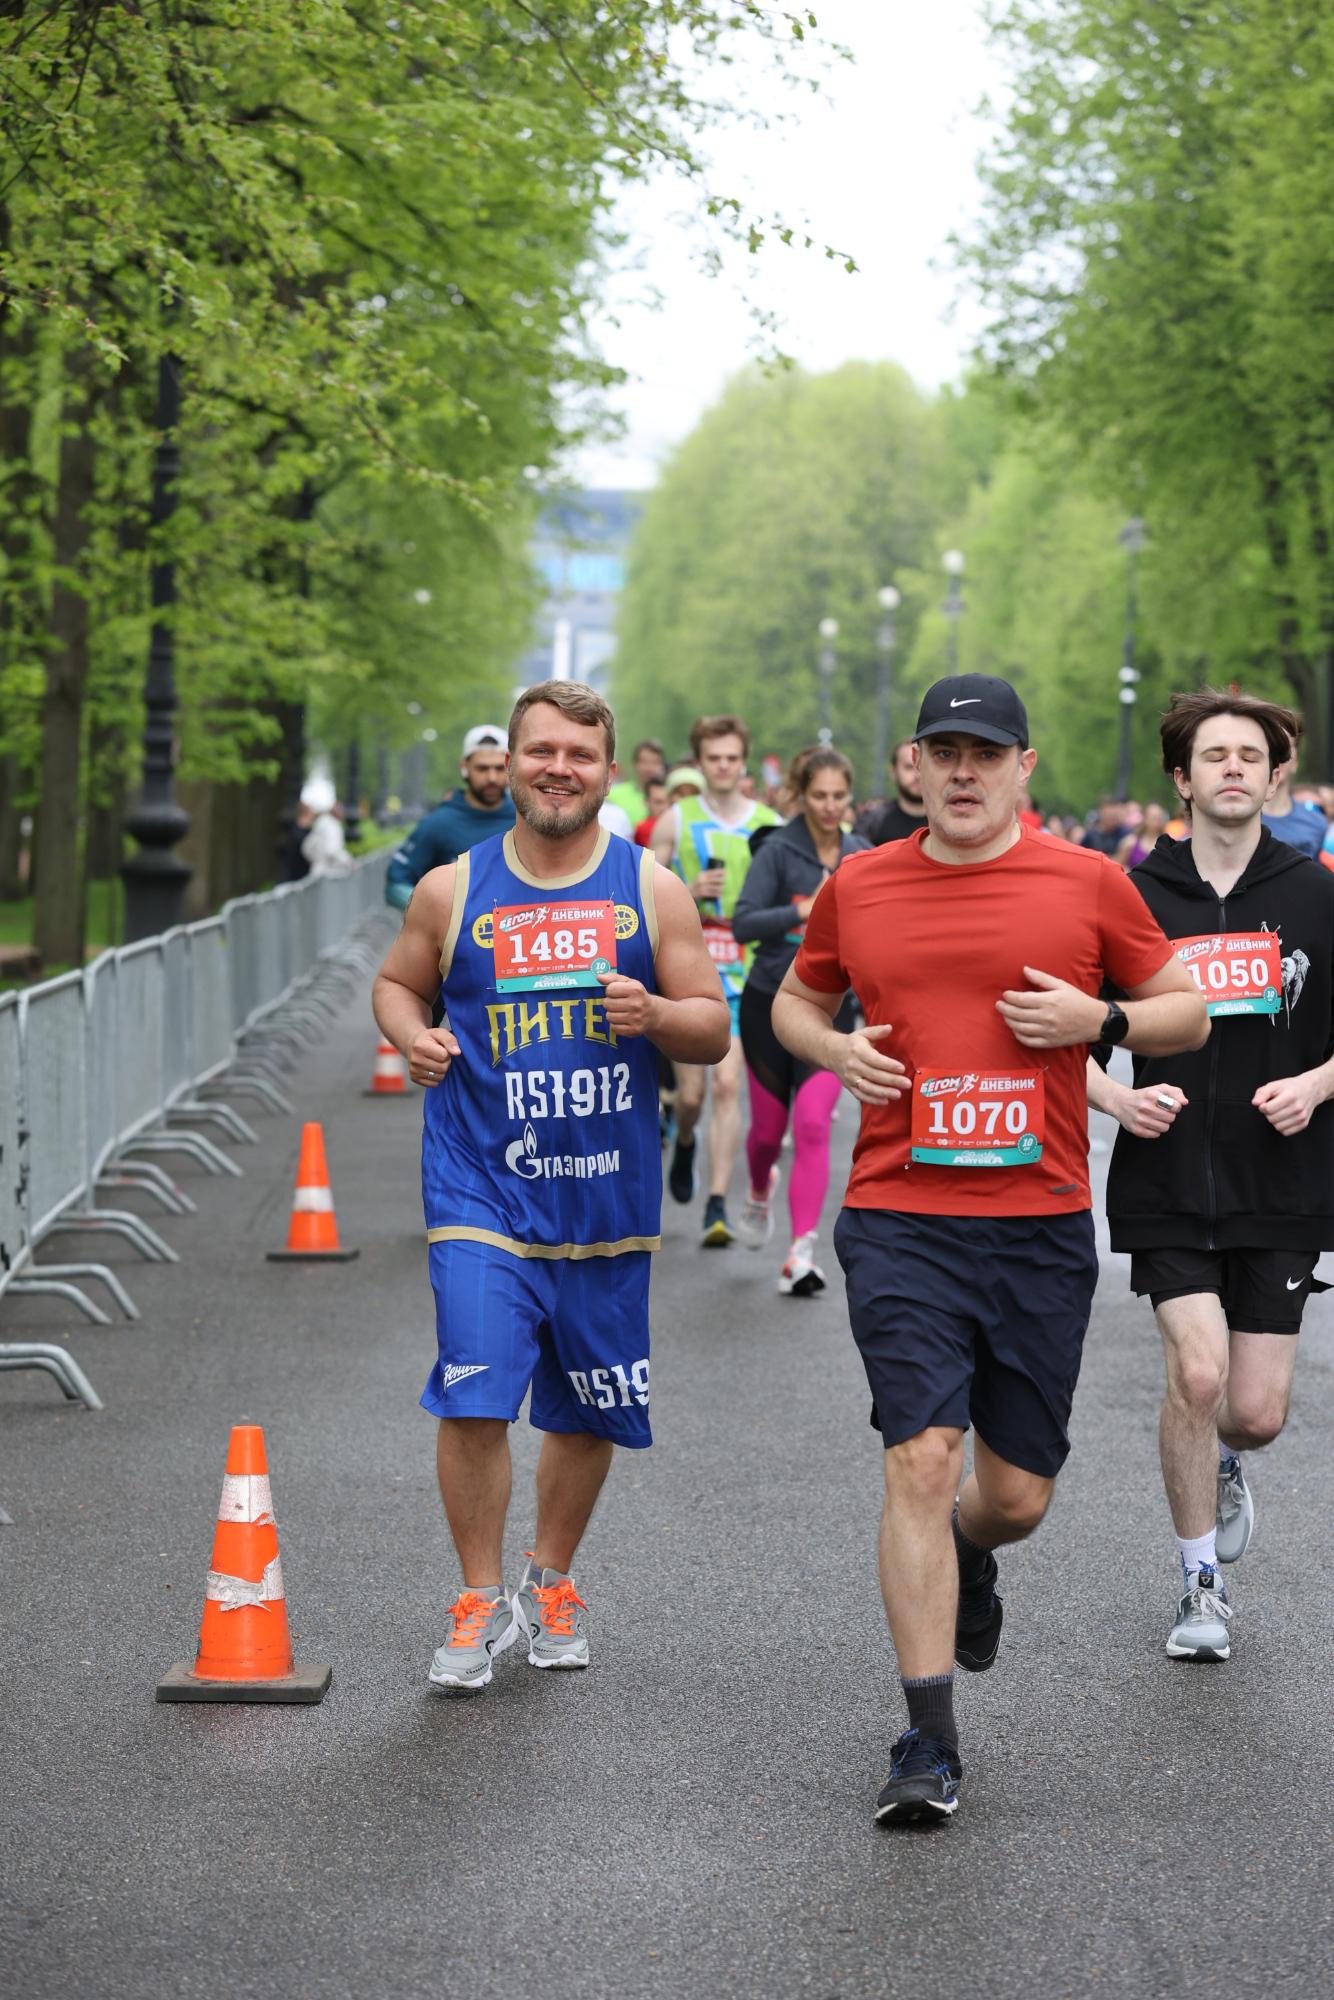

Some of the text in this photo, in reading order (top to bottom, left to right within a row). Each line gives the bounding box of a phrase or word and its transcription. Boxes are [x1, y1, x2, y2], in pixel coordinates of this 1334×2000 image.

[499, 909, 604, 929] БЕГОМ ДНЕВНИК
[509, 928, 598, 963] 1485
[1177, 939, 1271, 960] БЕГОМ ДНЕВНИК
[596, 962, 606, 970] 10
[1187, 958, 1269, 990] 1050
[505, 1062, 633, 1120] RS1912
[920, 1076, 1035, 1094] БЕГОМ ДНЕВНИК
[928, 1100, 1028, 1135] 1070
[1023, 1138, 1033, 1147] 10
[543, 1150, 620, 1179] ГАЗПРОМ
